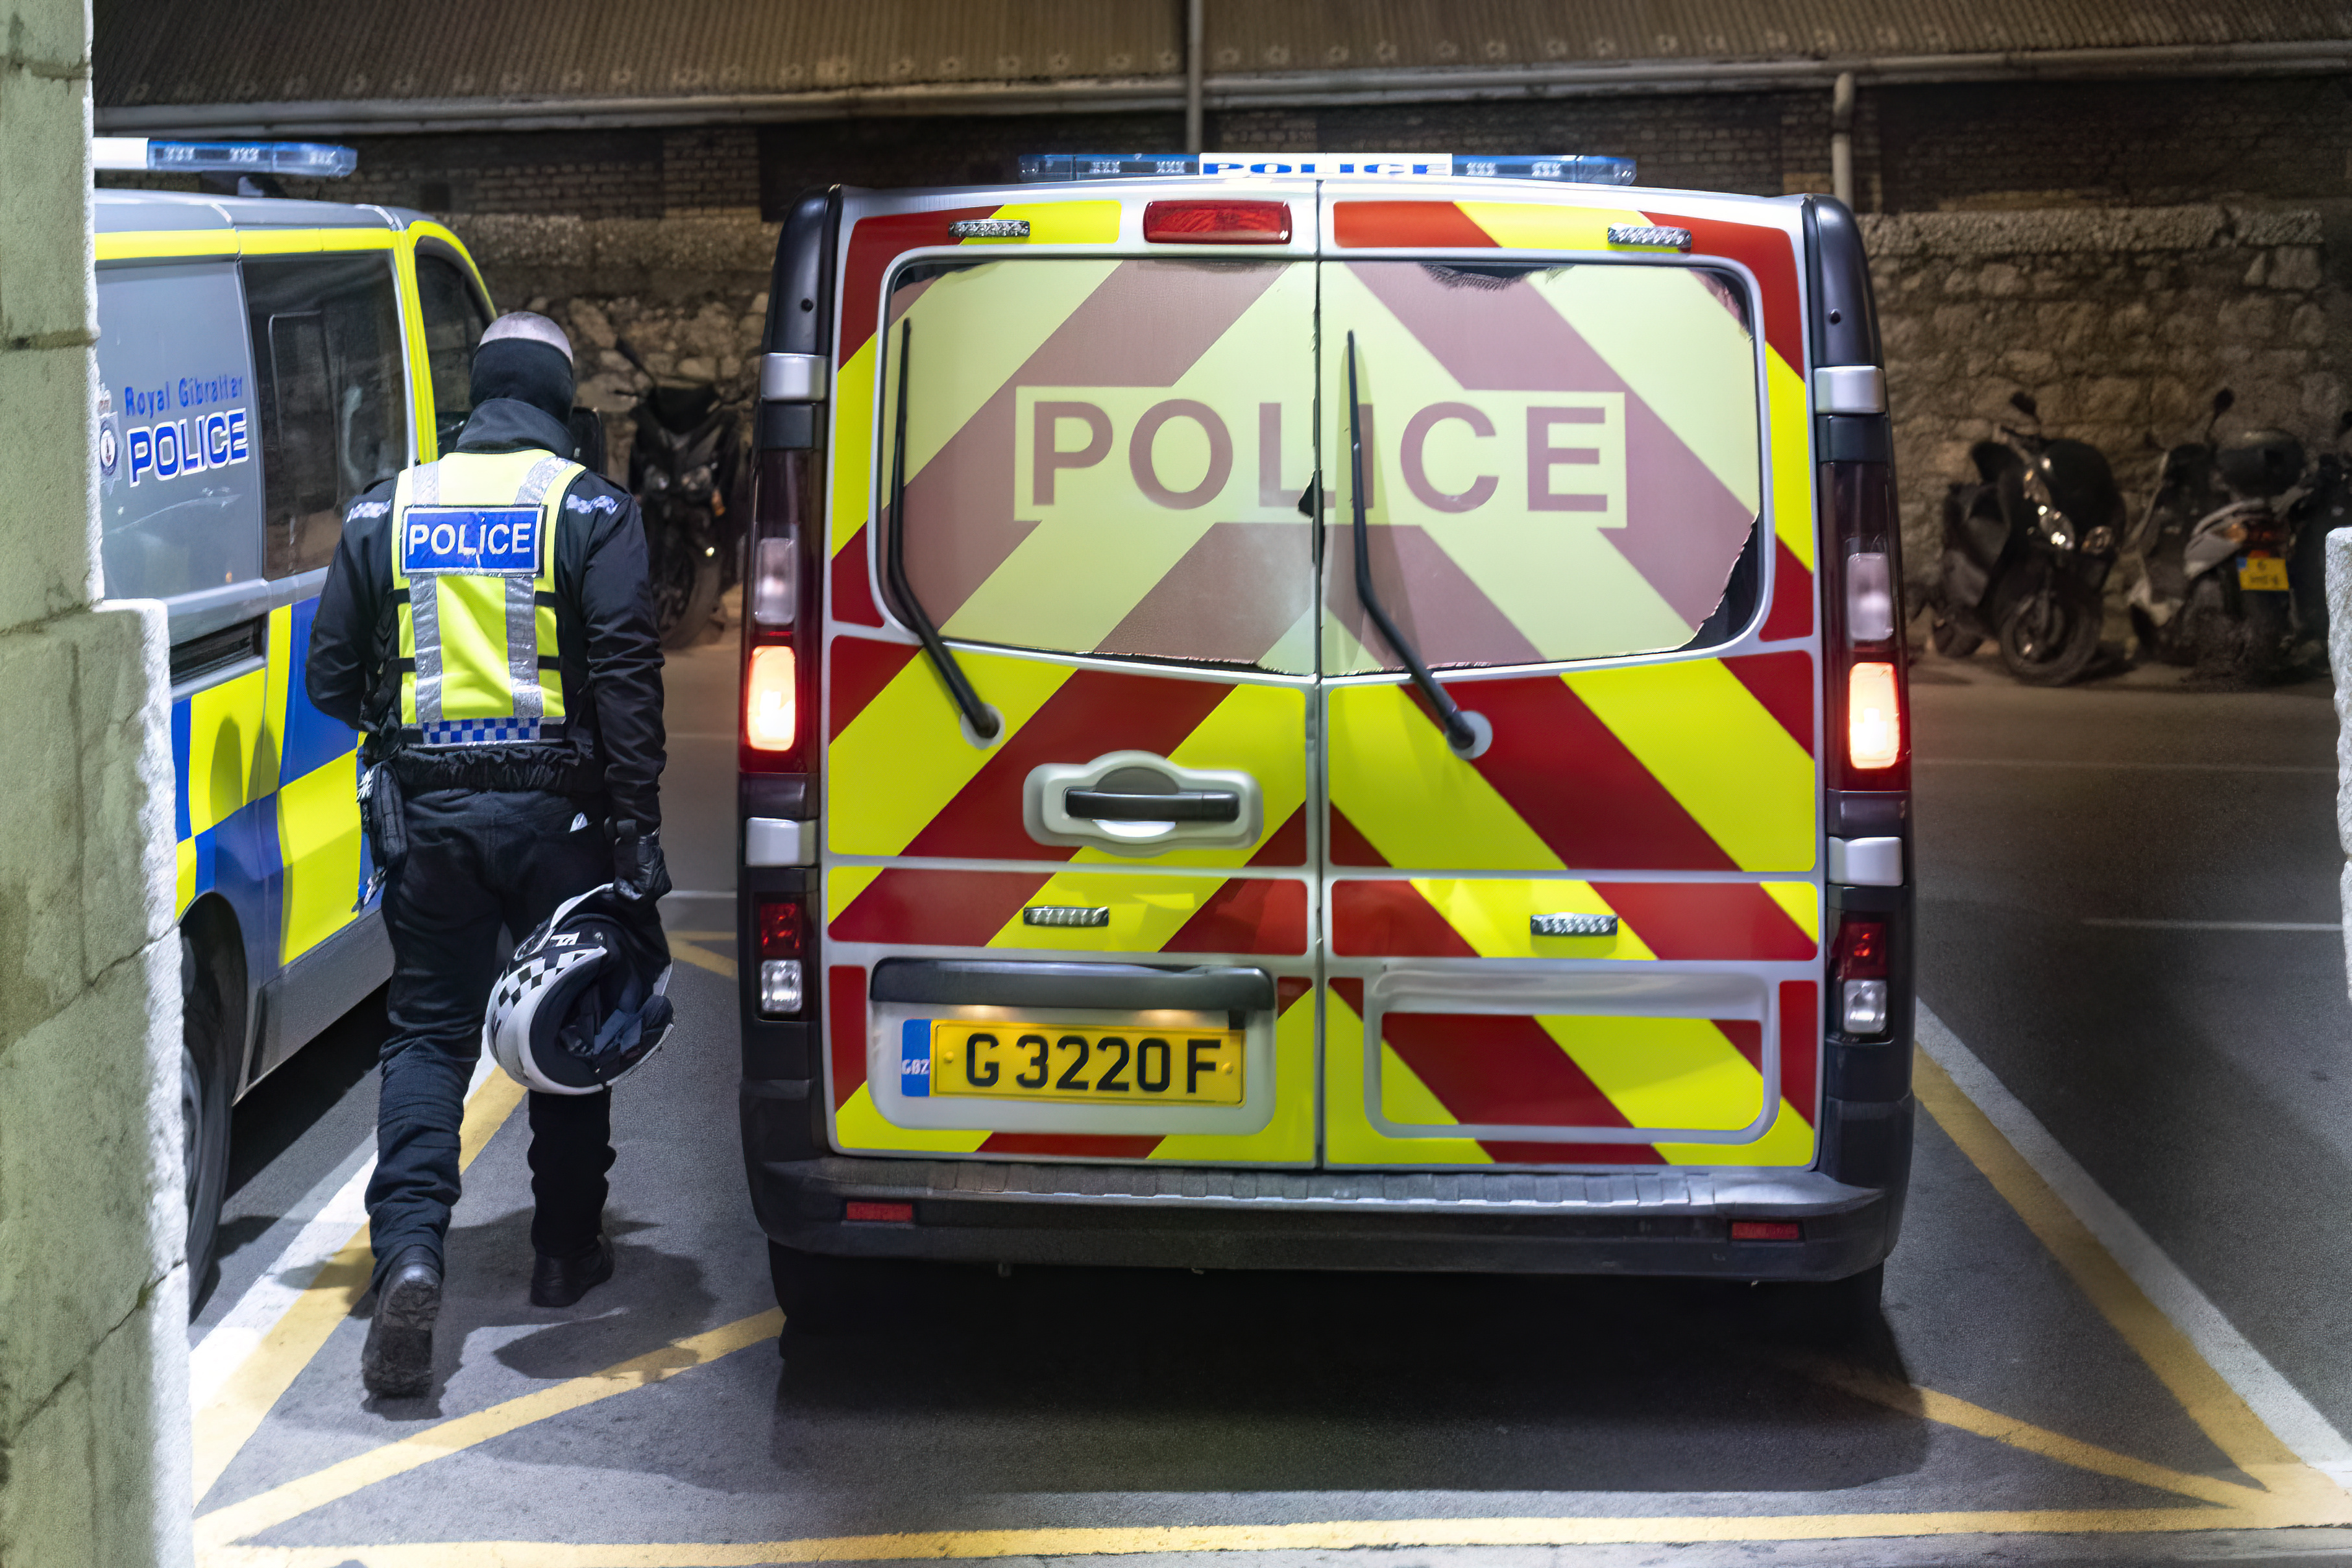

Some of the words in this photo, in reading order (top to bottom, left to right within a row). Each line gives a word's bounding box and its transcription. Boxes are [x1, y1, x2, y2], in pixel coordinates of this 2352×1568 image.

[1203, 162, 1448, 175] POLICE
[125, 381, 171, 419] Royal
[178, 374, 243, 407] Gibraltar
[127, 407, 249, 487] POLICE
[1032, 398, 1608, 514] POLICE
[408, 522, 532, 556] POLICE
[902, 1059, 929, 1075] GBZ
